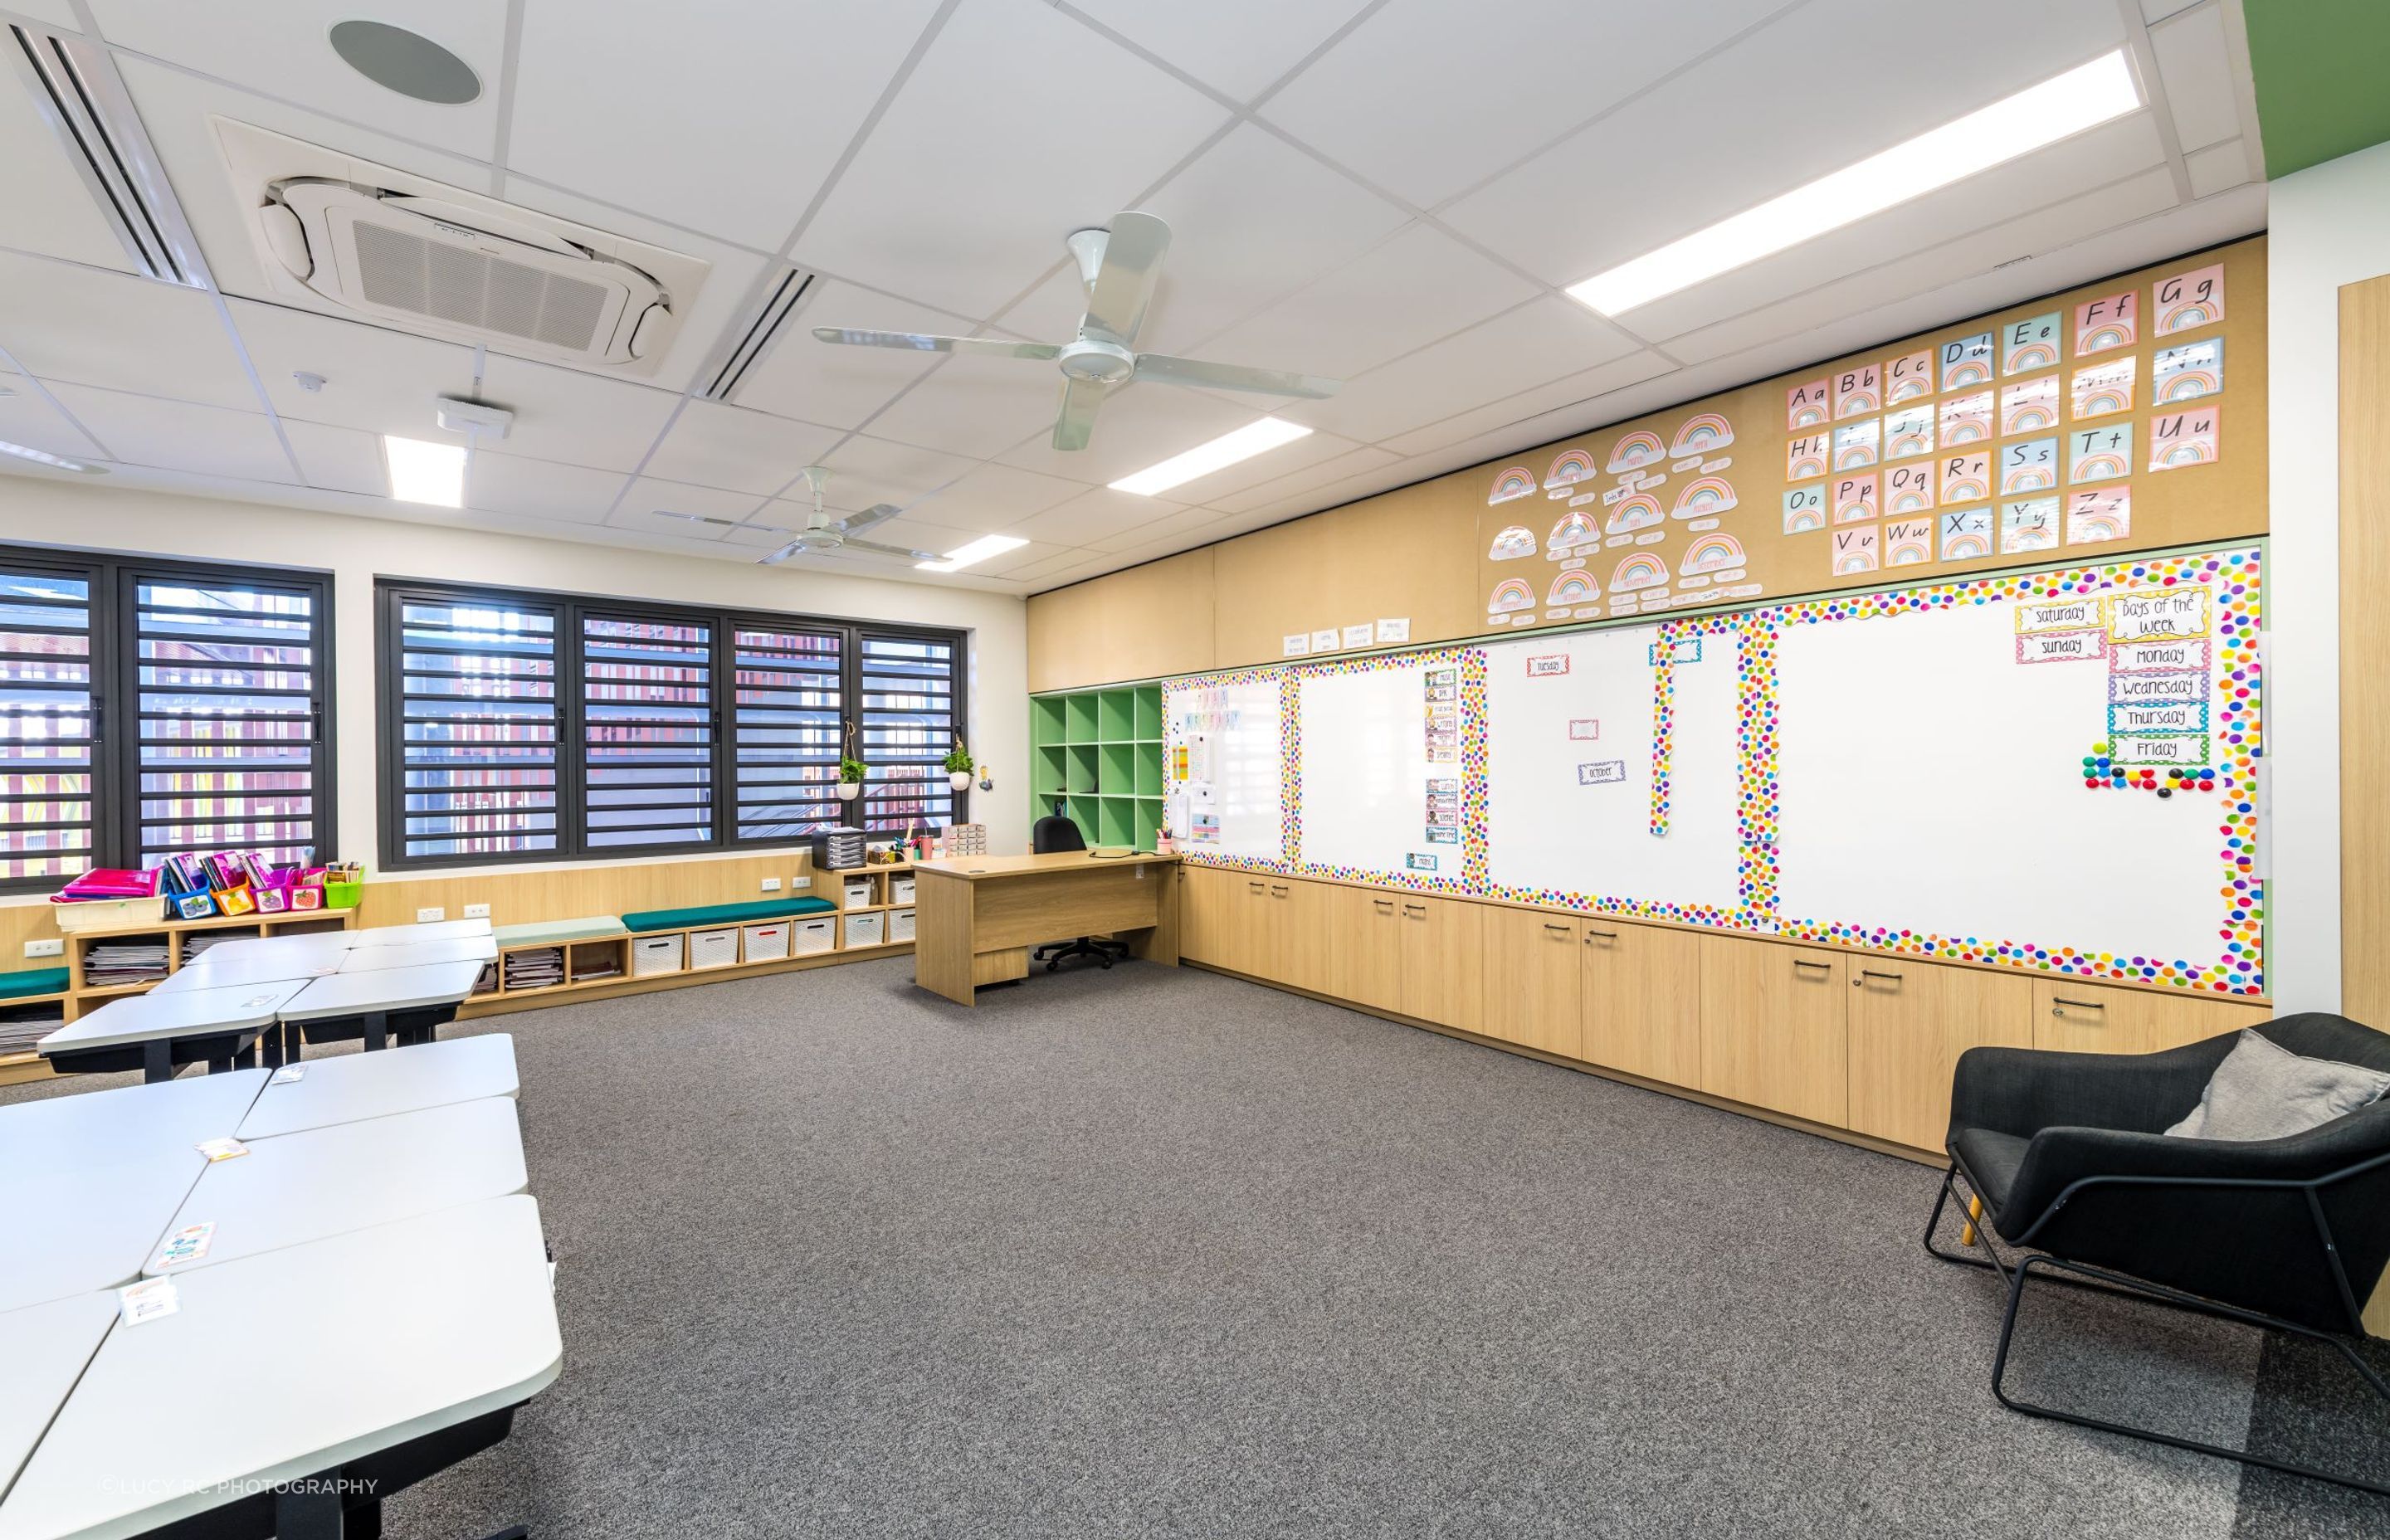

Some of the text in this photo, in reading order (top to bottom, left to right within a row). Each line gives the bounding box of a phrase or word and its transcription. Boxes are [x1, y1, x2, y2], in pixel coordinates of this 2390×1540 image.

[2036, 607, 2085, 623] Saturday
[2123, 597, 2194, 618] Days of the
[2139, 618, 2175, 634] Week
[2041, 640, 2082, 654] Sunday
[2137, 649, 2185, 664] Monday
[2123, 680, 2193, 695] Wednesday
[2128, 709, 2186, 725] Thursday
[2137, 742, 2178, 758] Friday
